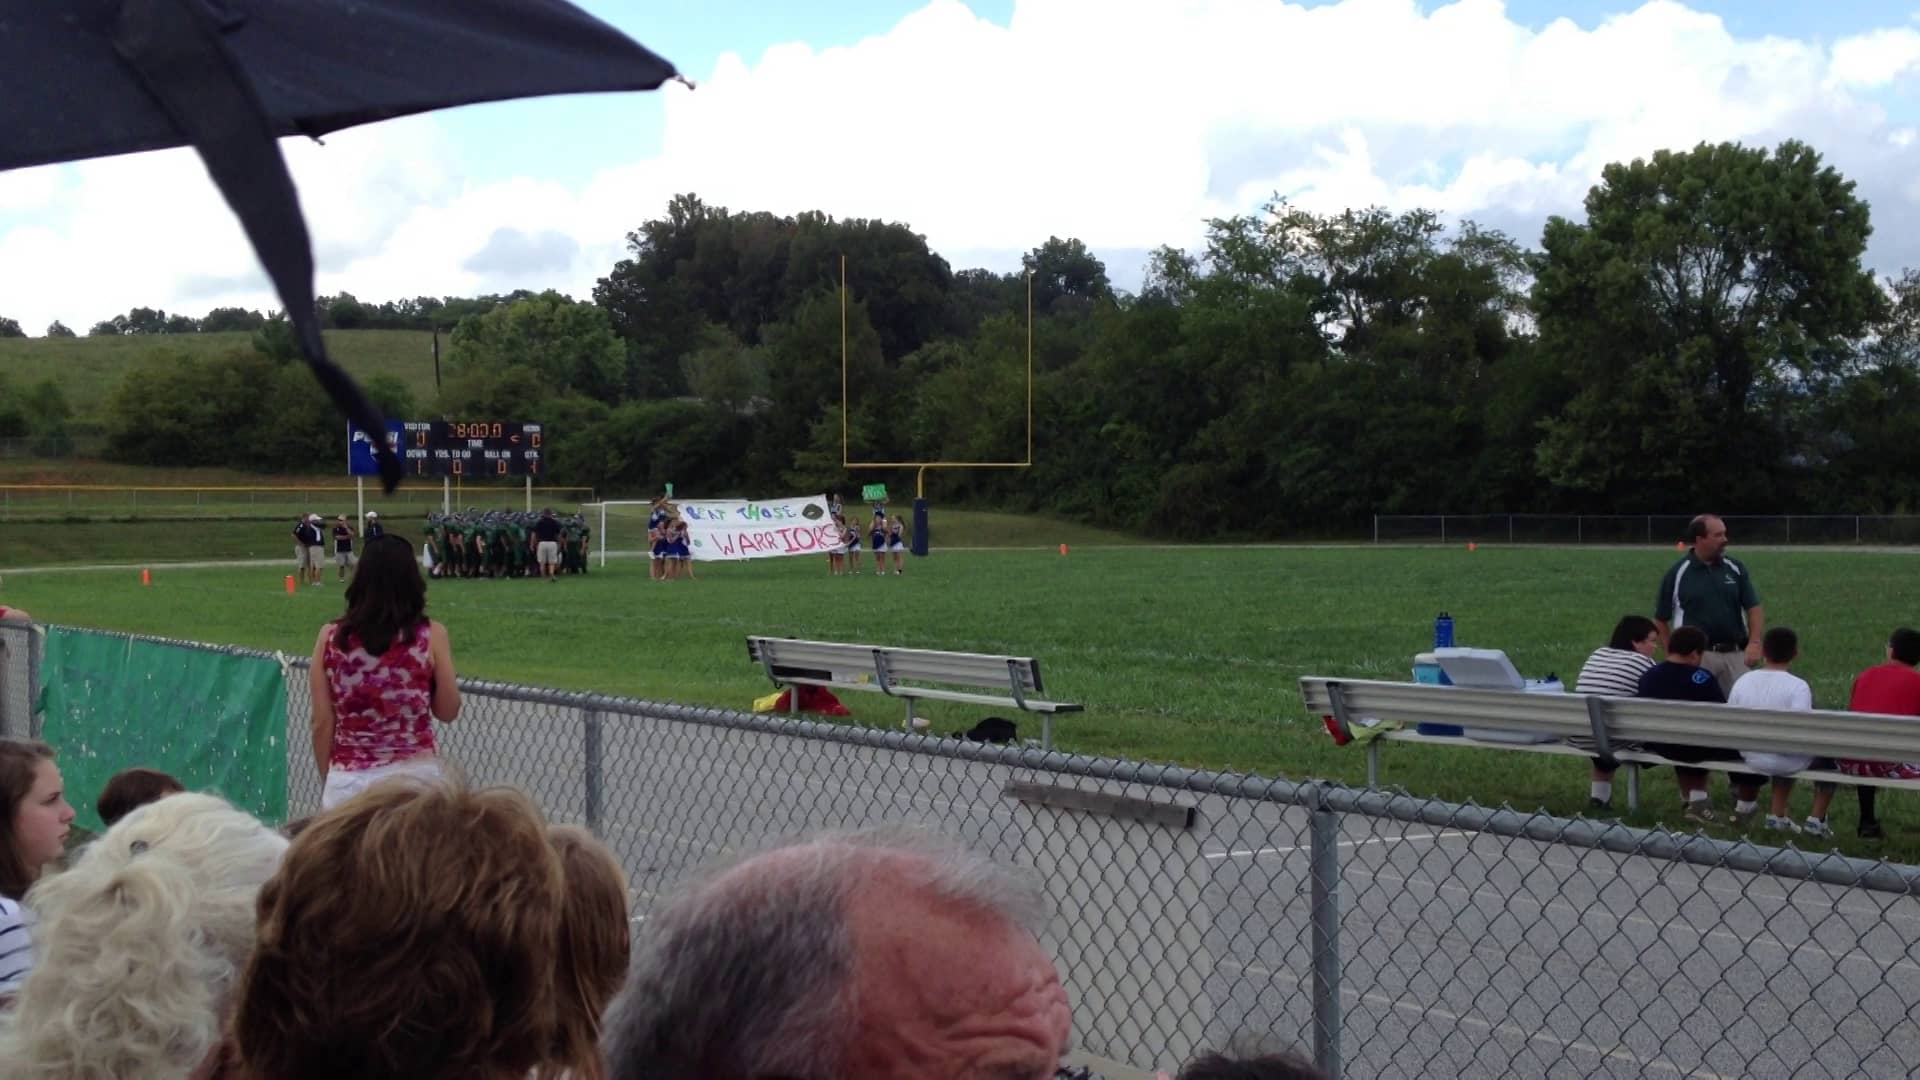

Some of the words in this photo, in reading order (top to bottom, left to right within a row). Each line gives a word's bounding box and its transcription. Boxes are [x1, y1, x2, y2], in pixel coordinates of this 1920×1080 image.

[404, 422, 430, 431] VISITOR
[468, 439, 483, 448] TIME
[406, 449, 427, 458] DOWN
[453, 459, 462, 474] 0
[686, 506, 727, 521] BEAT
[737, 503, 797, 521] THOSE
[711, 523, 841, 556] WARRIORS
